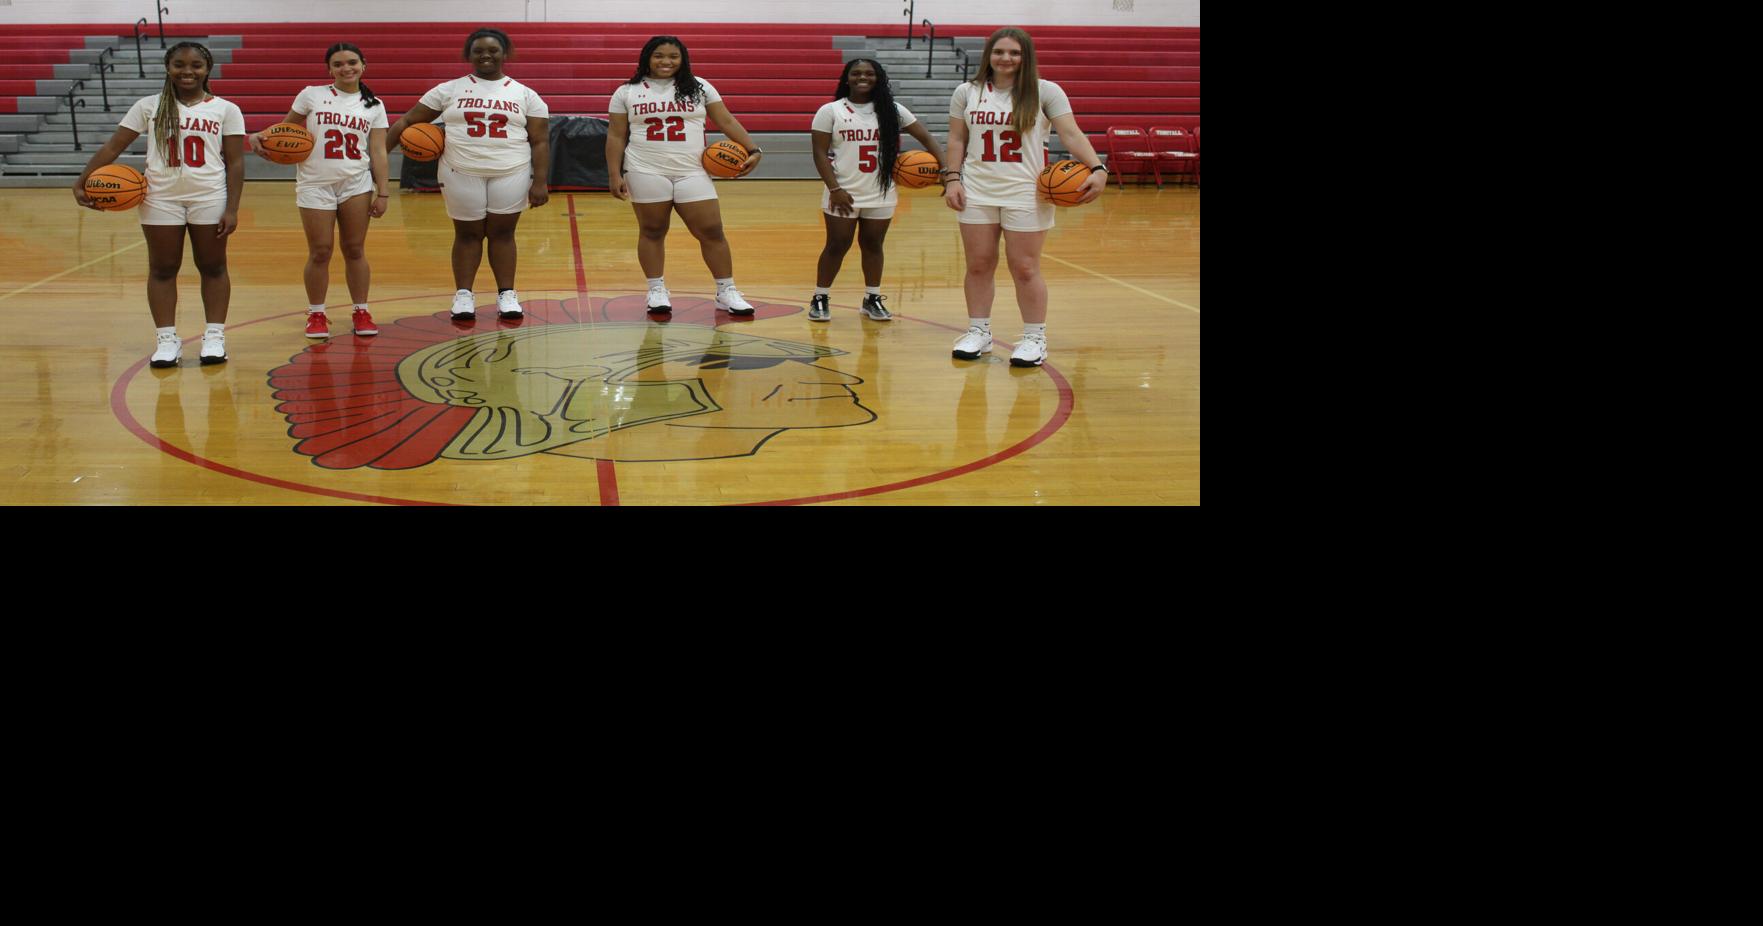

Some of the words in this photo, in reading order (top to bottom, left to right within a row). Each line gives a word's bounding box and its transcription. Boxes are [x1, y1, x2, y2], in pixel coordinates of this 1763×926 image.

[457, 98, 520, 114] TROJANS
[632, 101, 695, 116] TROJANS
[153, 117, 220, 136] JANS
[316, 111, 371, 134] TROJANS
[463, 111, 508, 139] 52
[644, 115, 686, 142] 22
[969, 111, 1015, 126] TROJA
[271, 126, 308, 137] Wilson
[839, 128, 880, 142] TROJA
[166, 135, 206, 168] 10
[324, 129, 362, 160] 20
[980, 129, 1023, 163] 12
[858, 144, 878, 174] 5
